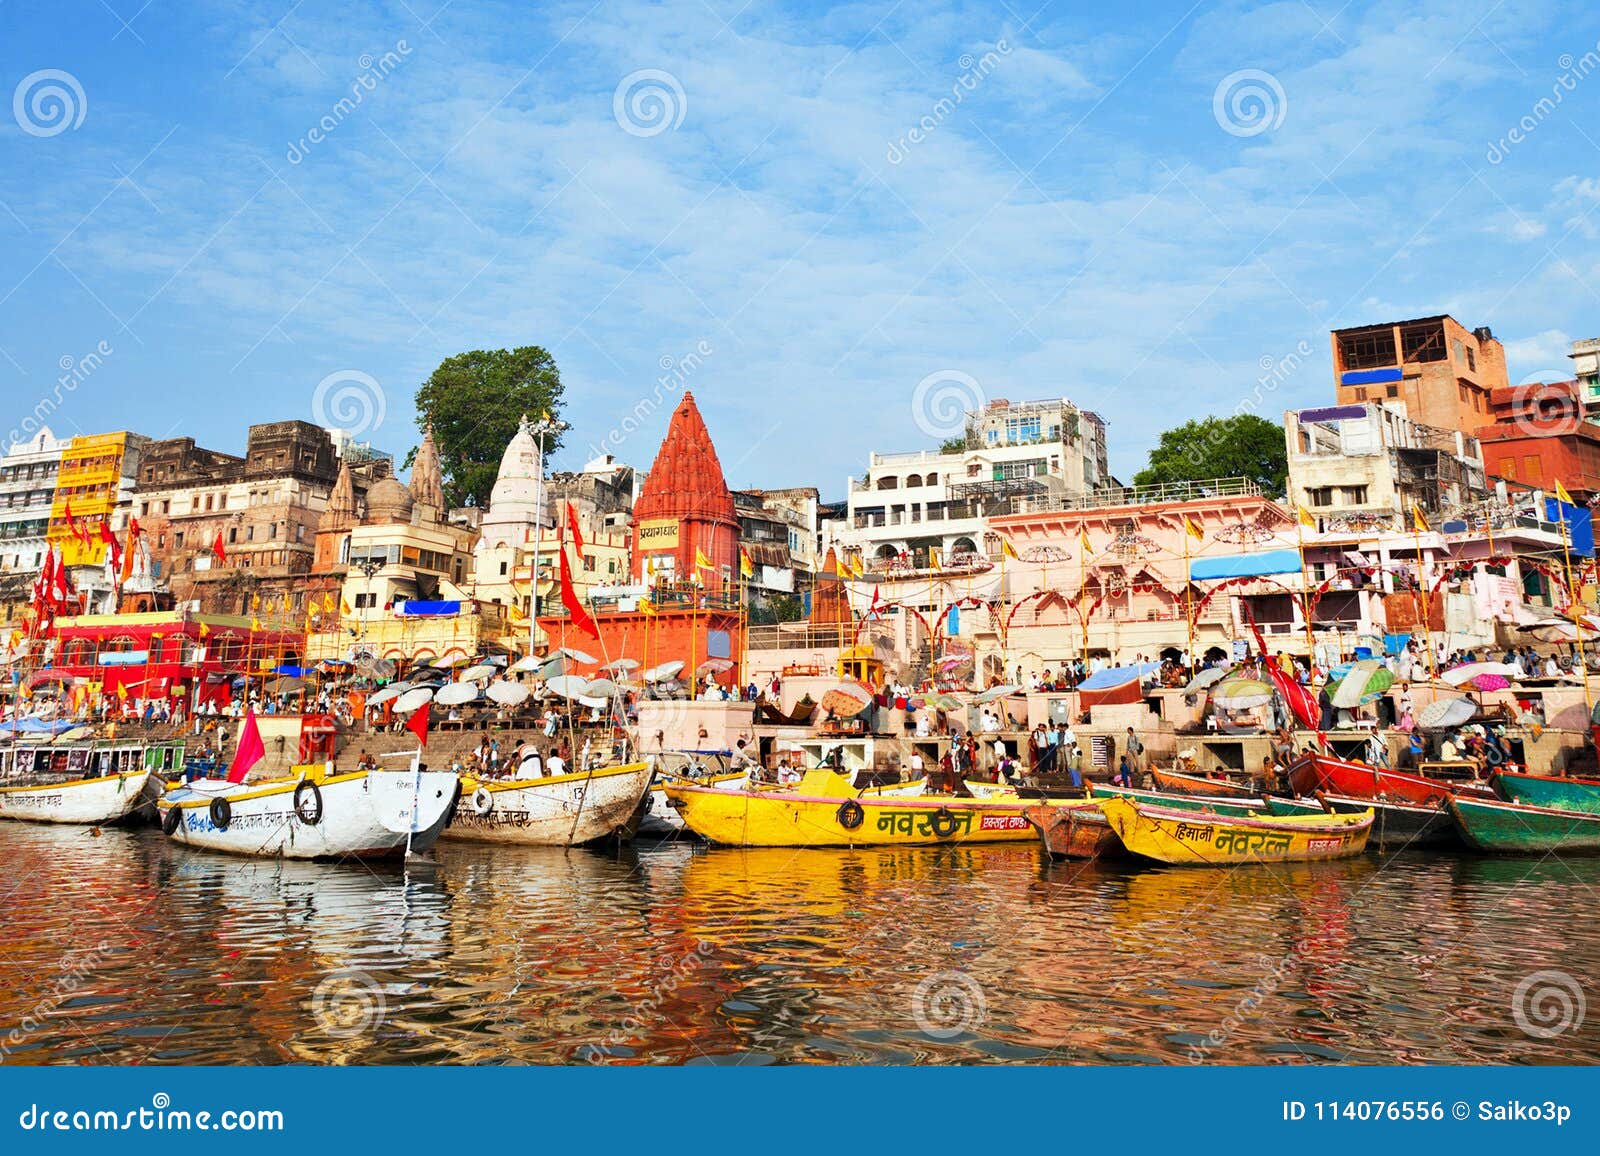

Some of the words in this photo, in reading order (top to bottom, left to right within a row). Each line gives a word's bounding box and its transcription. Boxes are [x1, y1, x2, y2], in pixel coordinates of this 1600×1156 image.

[573, 788, 584, 800] 13
[1175, 822, 1214, 842] हिमानी
[1215, 829, 1294, 857] नवरत्न
